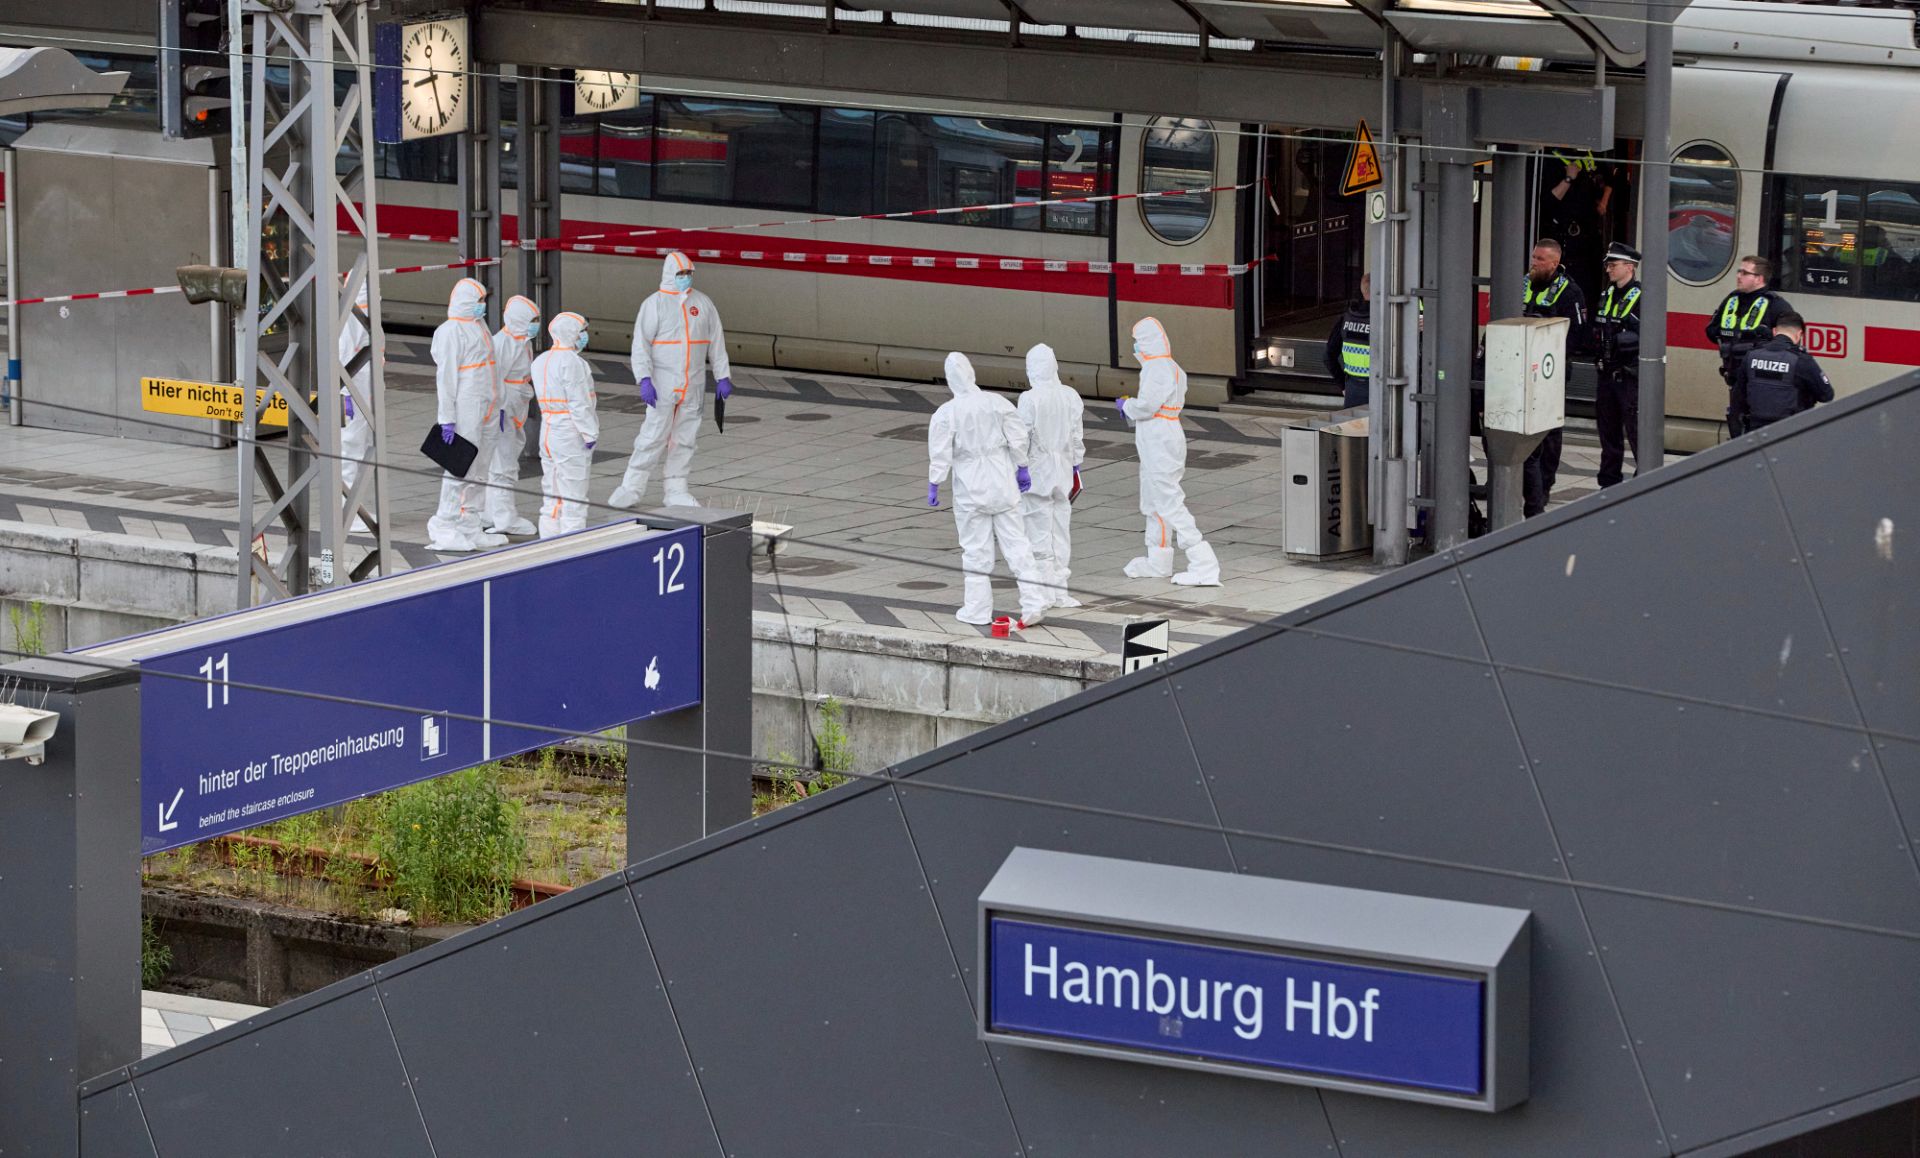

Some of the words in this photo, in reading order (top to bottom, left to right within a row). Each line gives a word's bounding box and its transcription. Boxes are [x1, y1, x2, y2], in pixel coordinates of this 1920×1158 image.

[1057, 129, 1083, 172] 2
[1819, 190, 1841, 229] 1
[1838, 277, 1848, 285] 66
[1343, 321, 1370, 334] POLIZE
[1808, 328, 1842, 353] DB
[1751, 358, 1790, 373] POLIZEI
[149, 380, 182, 398] Hier
[188, 386, 231, 404] nicht
[206, 405, 231, 417] Don't
[1327, 468, 1341, 538] Abfall
[653, 542, 685, 596] 12
[199, 652, 229, 709] 11
[199, 769, 240, 795] hinter
[243, 761, 268, 784] der
[270, 726, 404, 776] Treppeneinhausung
[198, 809, 227, 828] behind
[227, 806, 240, 820] the
[241, 798, 276, 817] staircase
[277, 787, 315, 807] enclosure
[1024, 943, 1263, 1040] Hamburg
[1286, 977, 1380, 1043] Hbf
